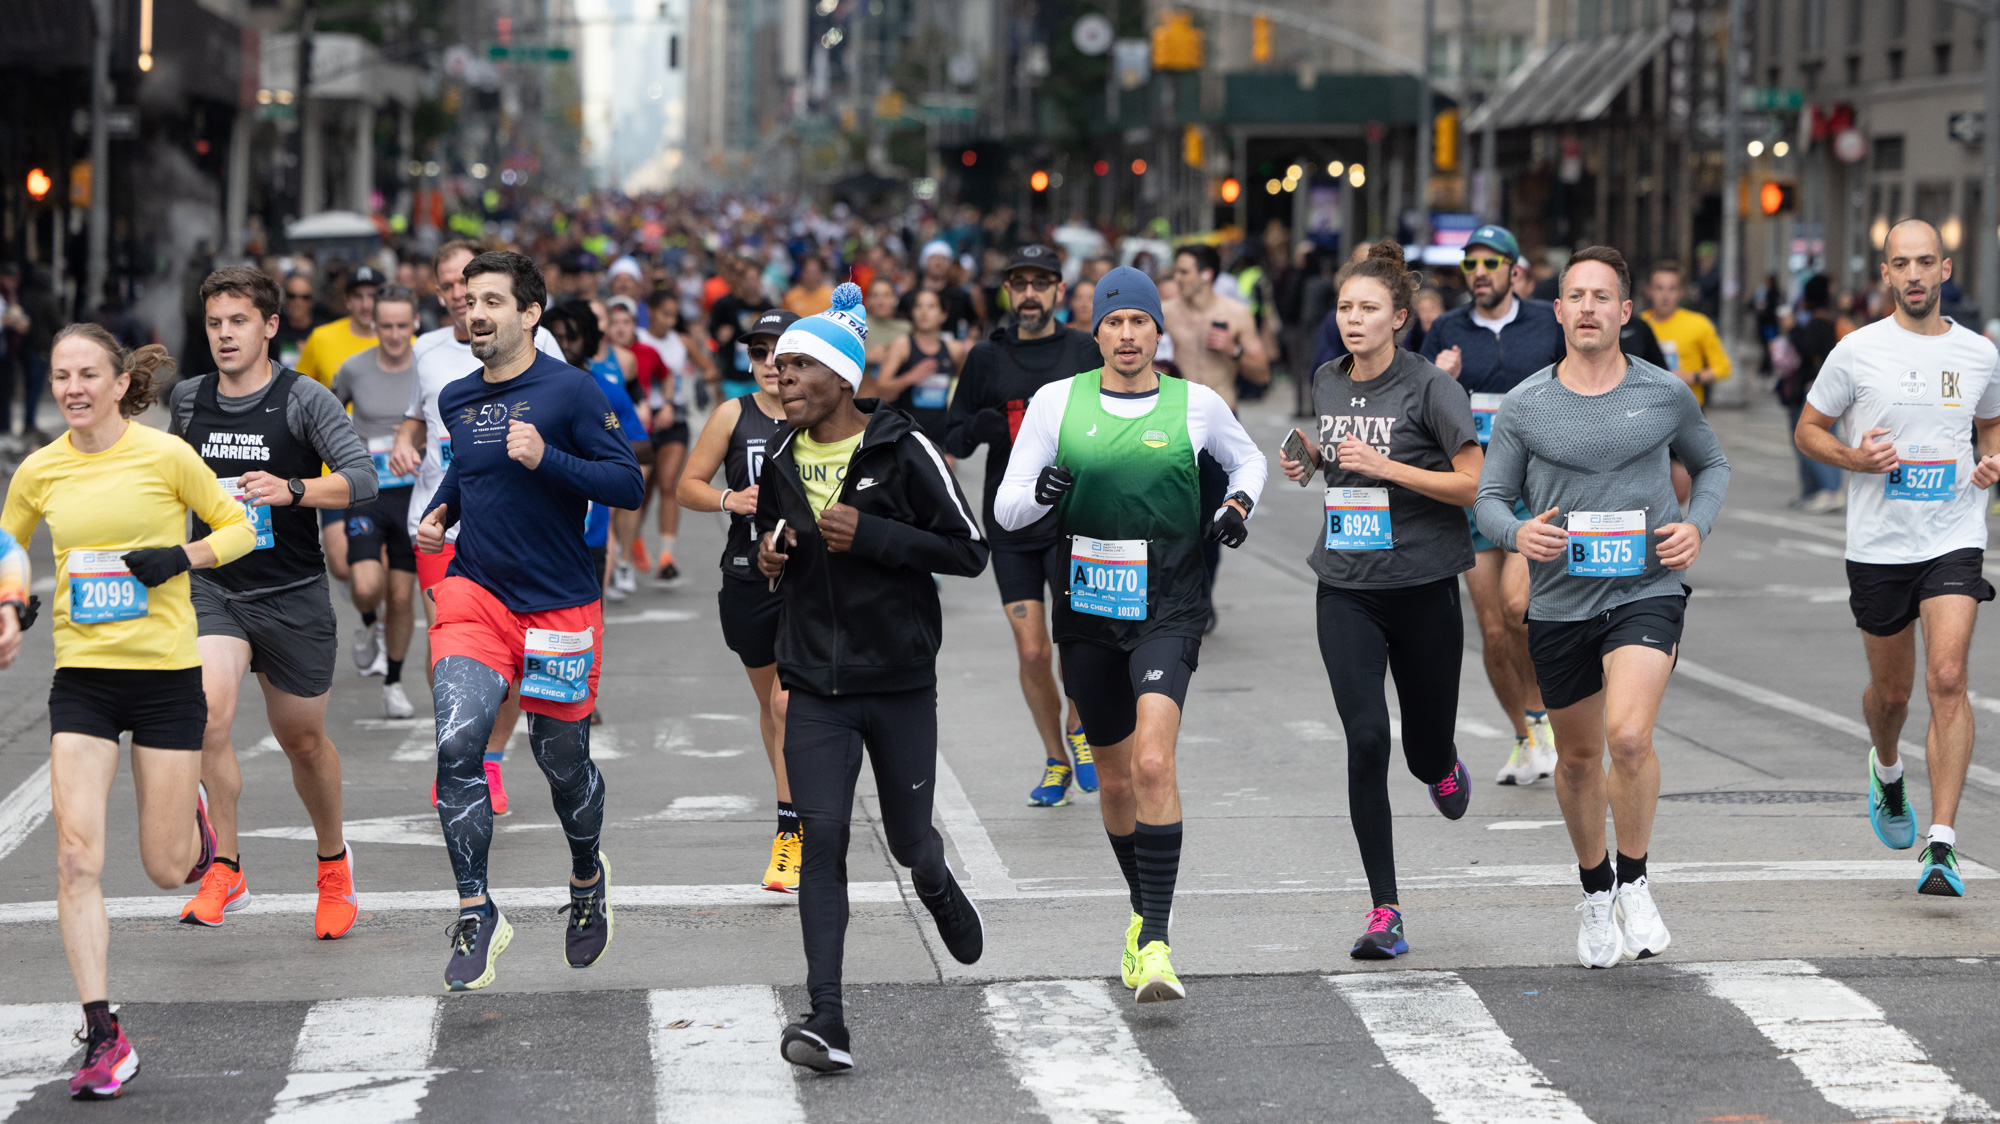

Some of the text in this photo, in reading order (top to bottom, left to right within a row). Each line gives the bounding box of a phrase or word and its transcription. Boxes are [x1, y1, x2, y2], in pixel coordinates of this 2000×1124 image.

[208, 432, 265, 446] NEW YORK
[1320, 414, 1397, 444] PENN
[201, 443, 271, 461] HARRIERS
[441, 446, 451, 460] B
[1906, 467, 1946, 489] 5277
[1343, 514, 1381, 537] 6924
[1572, 539, 1632, 563] B 1575
[81, 580, 135, 608] 2099
[1074, 601, 1140, 617] BAG CHECK 10170
[546, 657, 585, 681] 6150
[524, 685, 540, 694] BAG
[541, 688, 566, 698] CHECK
